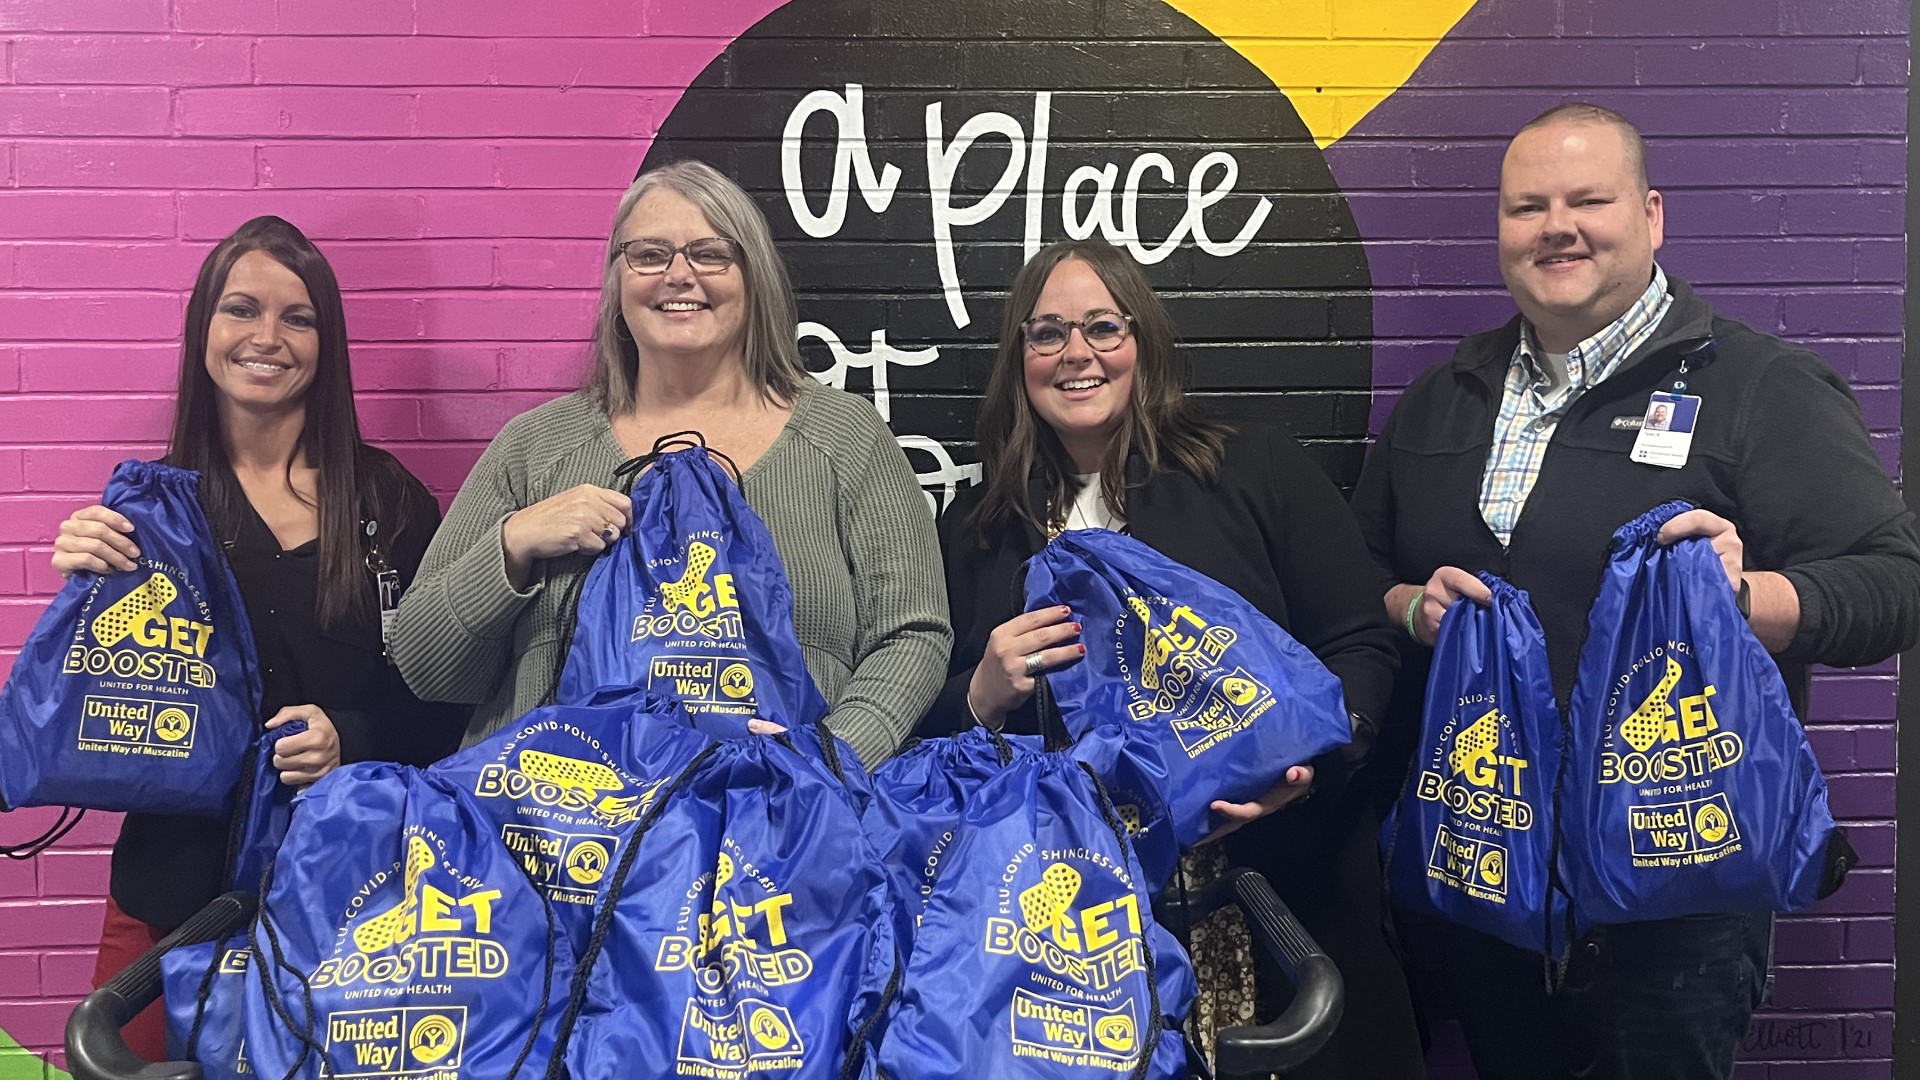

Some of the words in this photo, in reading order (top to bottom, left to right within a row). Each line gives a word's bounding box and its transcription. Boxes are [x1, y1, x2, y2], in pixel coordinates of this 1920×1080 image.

[781, 83, 902, 238] a
[926, 90, 1274, 329] place
[690, 573, 739, 618] GE
[132, 613, 214, 658] GET
[631, 610, 745, 642] BOOST
[665, 640, 697, 648] UNITED
[718, 642, 746, 650] HEALTH
[62, 645, 216, 688] BOOSTED
[654, 661, 712, 678] United
[1128, 625, 1238, 721] BOOSTED
[99, 680, 134, 690] UNITED
[135, 683, 153, 691] FOR
[155, 685, 189, 695] HEALTH
[675, 679, 711, 699] Way
[88, 701, 148, 720] United
[700, 704, 710, 713] of
[711, 705, 756, 715] Muscatine
[1176, 693, 1196, 717] UNITED
[1192, 682, 1202, 694] FOR
[1175, 696, 1225, 731] United
[1201, 709, 1234, 731] Way
[109, 719, 146, 741] Way
[1188, 738, 1215, 759] United
[1214, 729, 1233, 742] Way
[1233, 724, 1242, 733] of
[1241, 697, 1277, 729] Muscatine
[78, 741, 109, 752] United
[110, 744, 130, 755] Way
[131, 745, 142, 754] of
[143, 746, 190, 758] Muscatine
[1663, 785, 1682, 794] FOR
[516, 806, 550, 818] UNITED
[552, 813, 572, 825] FOR
[1464, 822, 1481, 831] FOR
[1632, 808, 1687, 829] United
[506, 831, 562, 856] United
[1650, 829, 1688, 850] Way
[1632, 857, 1659, 867] United
[1660, 857, 1681, 867] Way
[1682, 855, 1692, 865] of
[1694, 843, 1742, 864] Muscatine
[551, 890, 597, 905] Muscati
[394, 884, 502, 943] GET
[308, 937, 509, 988] BOOSTED
[344, 988, 381, 999] UNITED
[383, 988, 403, 996] FOR
[406, 984, 451, 995] HEALTH
[1030, 971, 1063, 991] UNITED
[1065, 985, 1083, 999] FOR
[1086, 987, 1122, 1002] HEALTH
[697, 995, 727, 1008] NITED
[1016, 996, 1086, 1026] United
[332, 1015, 399, 1042] United
[1043, 1022, 1087, 1049] Way
[354, 1042, 398, 1070] Way
[709, 1037, 746, 1064] Way
[1012, 1044, 1049, 1059] United
[1050, 1051, 1074, 1067] Way
[1076, 1054, 1088, 1066] of
[676, 1063, 714, 1078] United
[716, 1069, 742, 1080] Way
[748, 1057, 803, 1072] Muscatine
